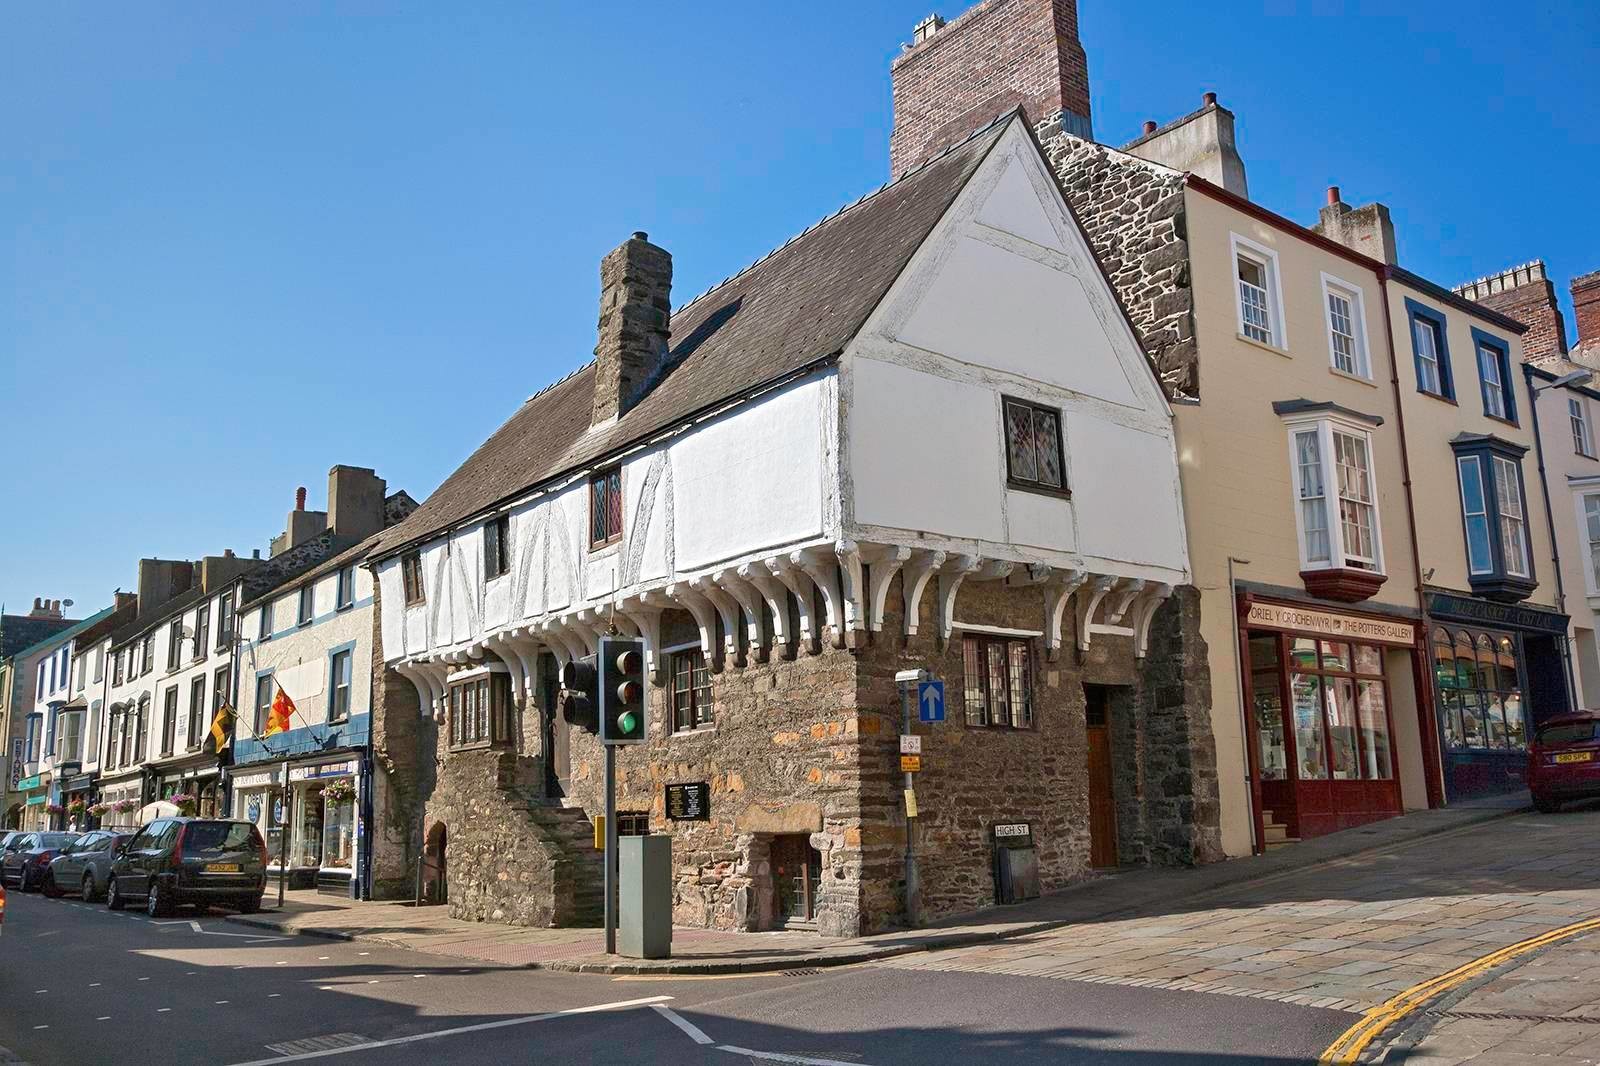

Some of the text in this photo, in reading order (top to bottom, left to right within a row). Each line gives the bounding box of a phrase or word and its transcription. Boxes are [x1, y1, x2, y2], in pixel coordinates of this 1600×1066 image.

[1251, 606, 1412, 639] ORIEL Y CROCHENWYR THE POTTERS GALLERY
[996, 825, 1015, 835] HIGH
